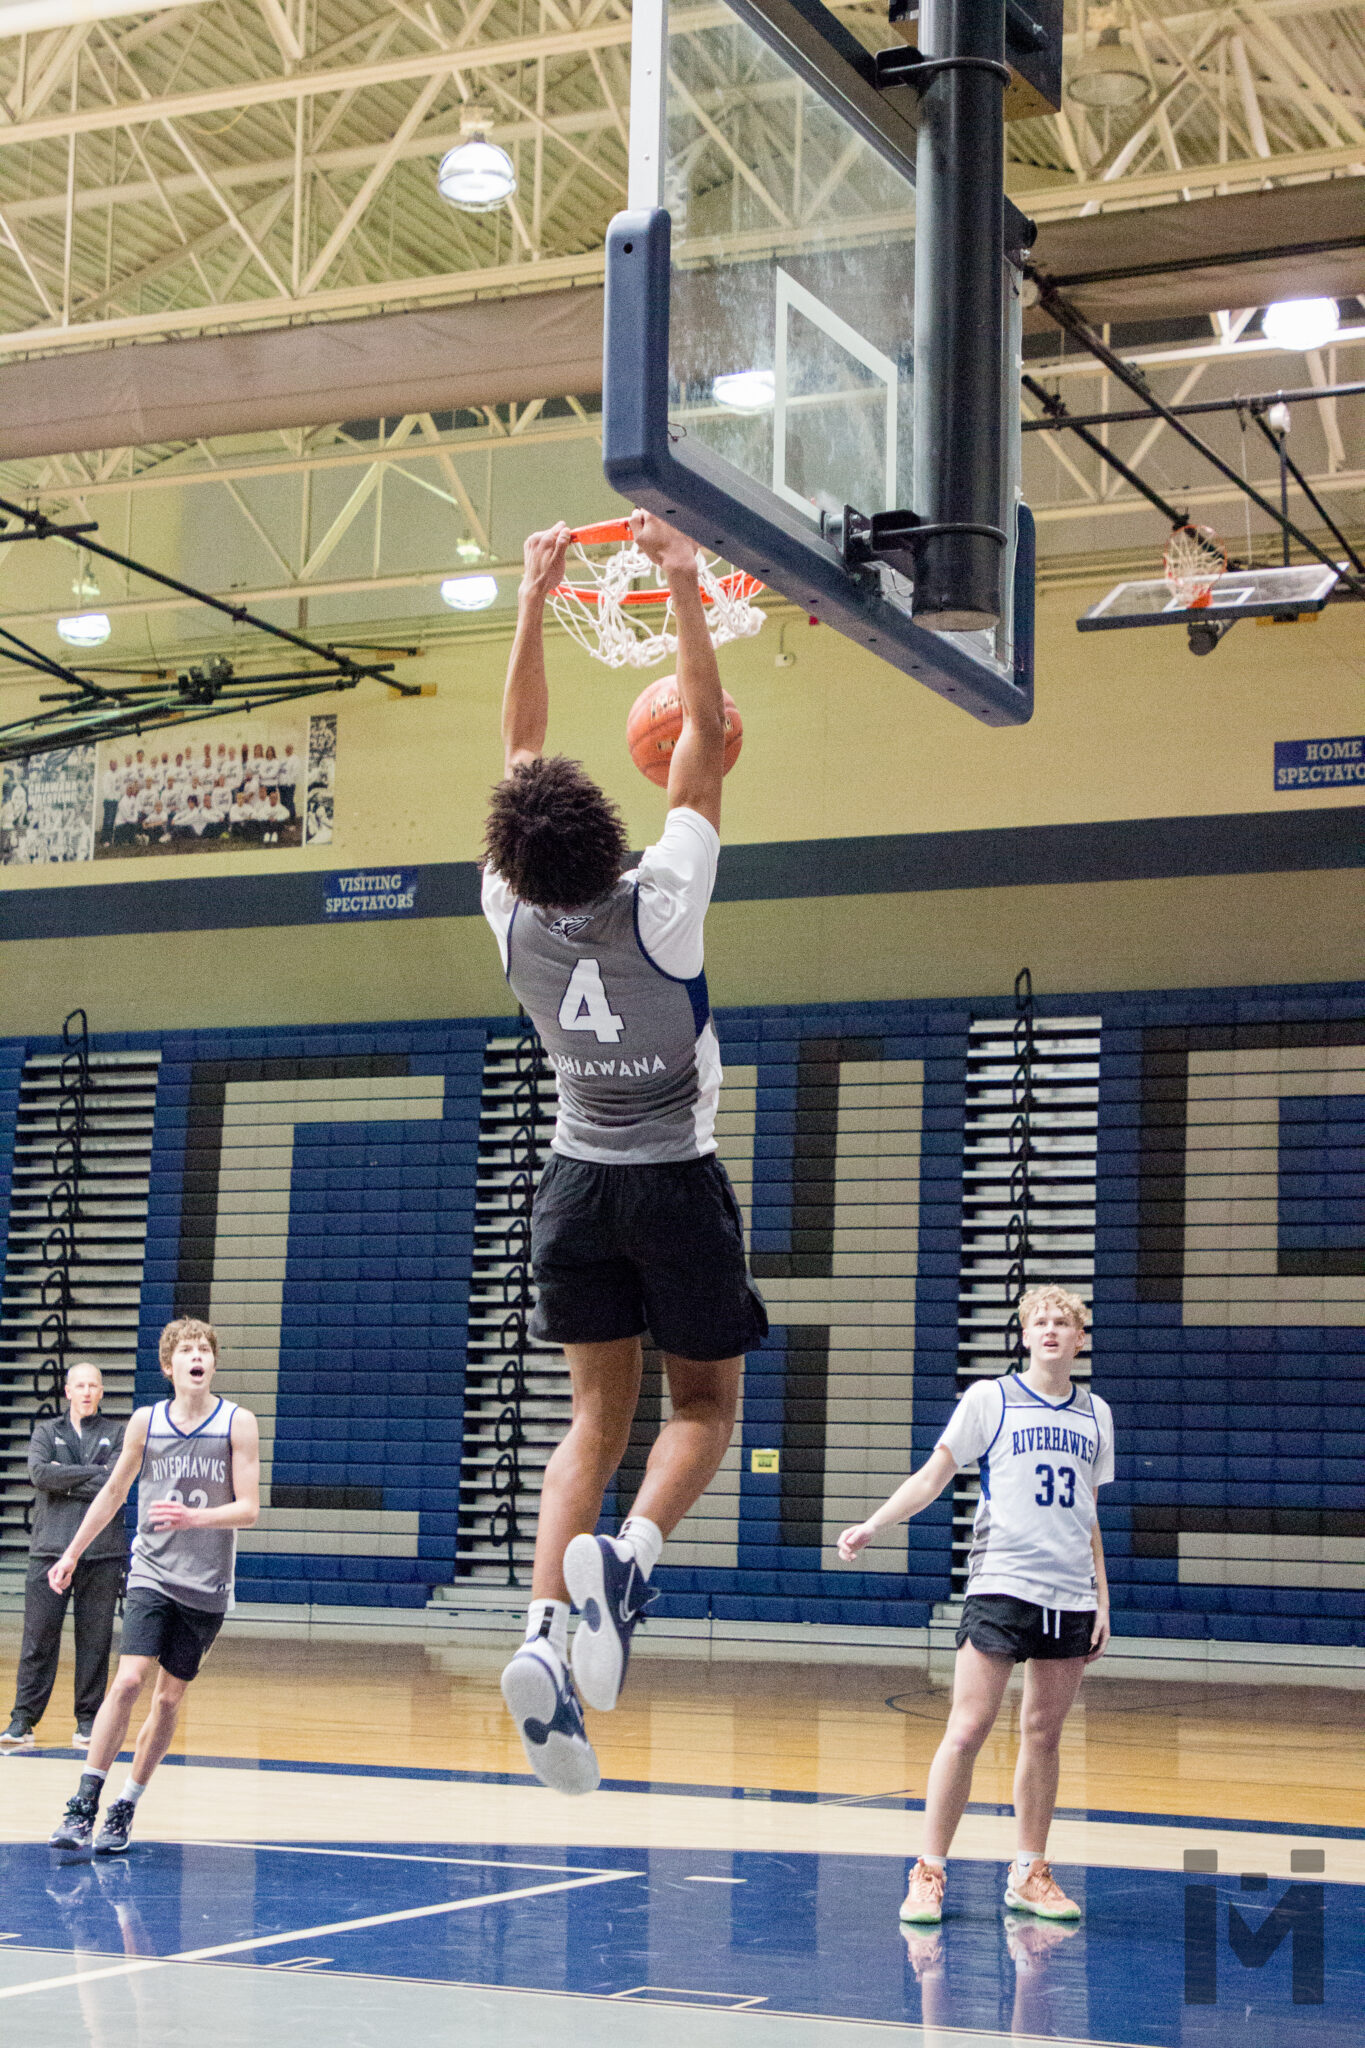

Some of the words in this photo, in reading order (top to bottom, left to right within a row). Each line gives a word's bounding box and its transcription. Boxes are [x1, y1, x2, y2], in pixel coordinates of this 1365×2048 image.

[1306, 741, 1362, 761] HOME
[339, 874, 402, 893] VISITING
[325, 893, 414, 913] SPECTATORS
[558, 957, 626, 1043] 4
[1012, 1426, 1095, 1465] RIVERHAWKS
[151, 1455, 226, 1484] RIVERHAWKS
[1035, 1463, 1076, 1509] 33
